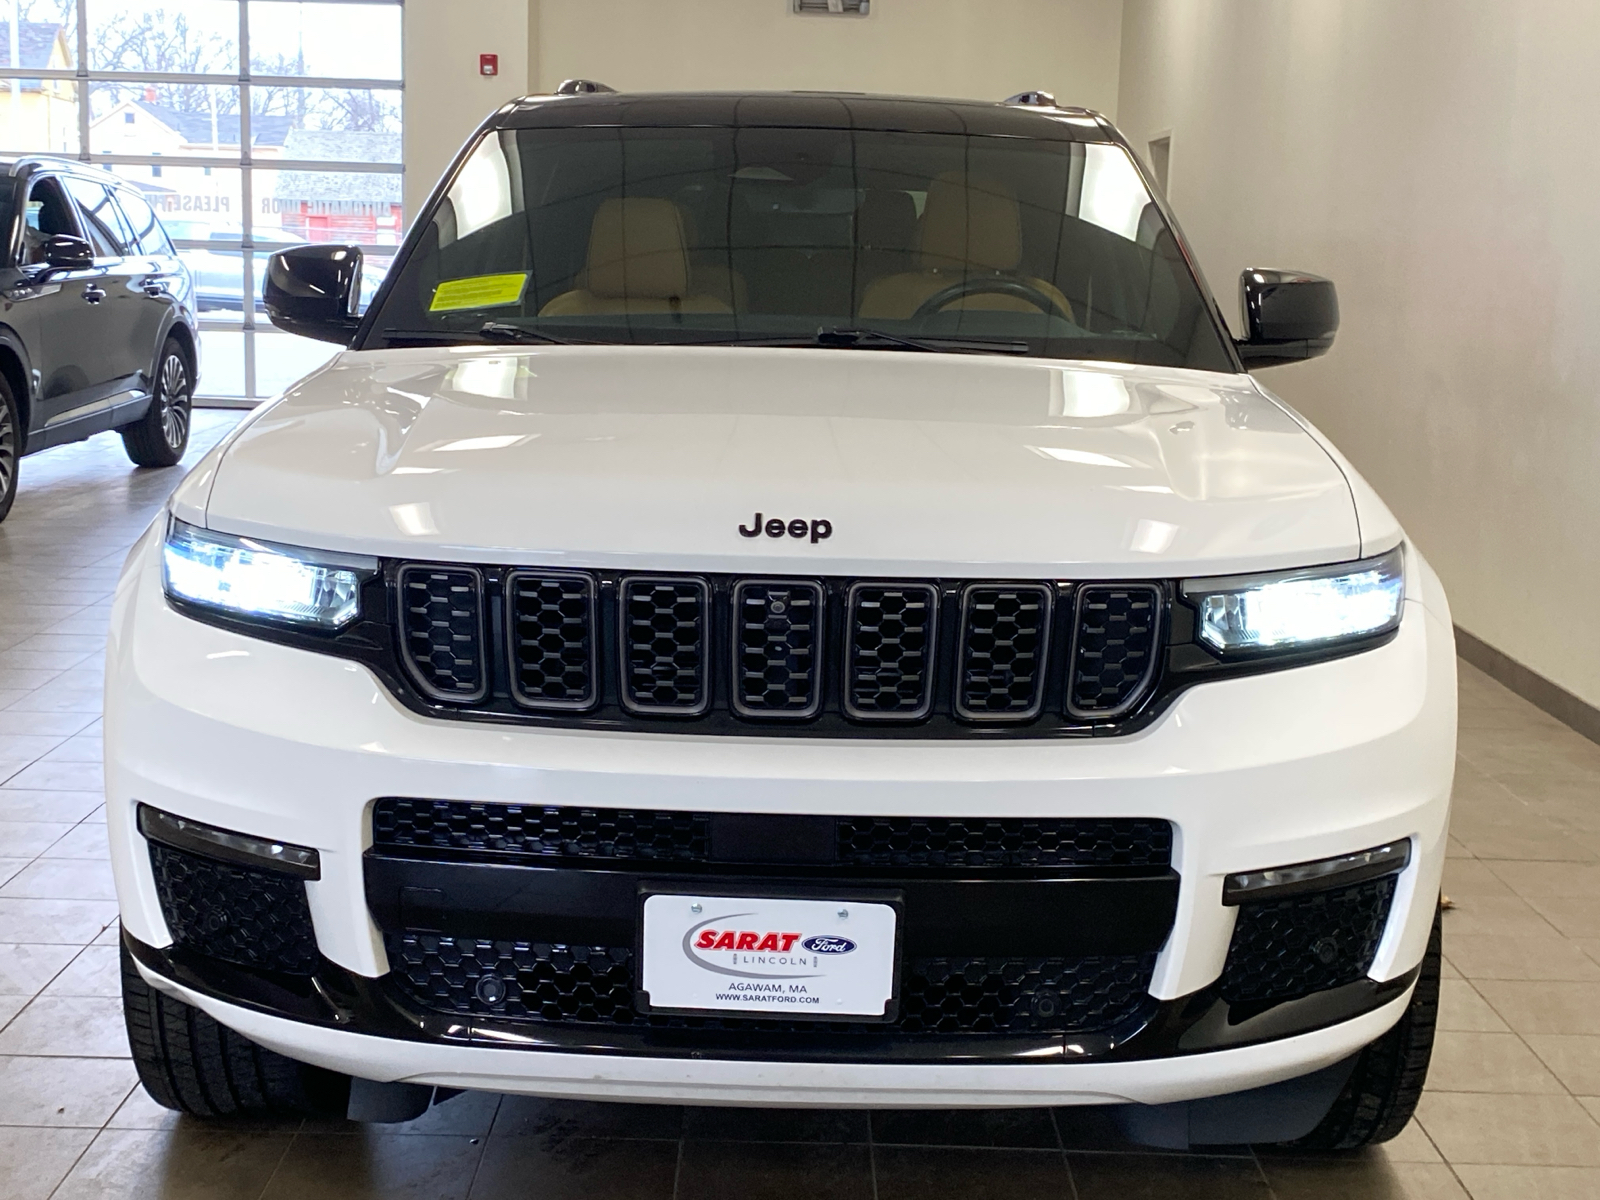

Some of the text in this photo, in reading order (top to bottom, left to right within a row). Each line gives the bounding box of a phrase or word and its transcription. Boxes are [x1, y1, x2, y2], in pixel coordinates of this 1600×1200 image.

[738, 512, 832, 544] Jeep
[695, 930, 848, 953] SARAT Ford
[743, 956, 807, 966] LINCOLN
[728, 983, 808, 994] AGAWAM, MA
[715, 993, 820, 1005] WWW.SARATFORD.COM
